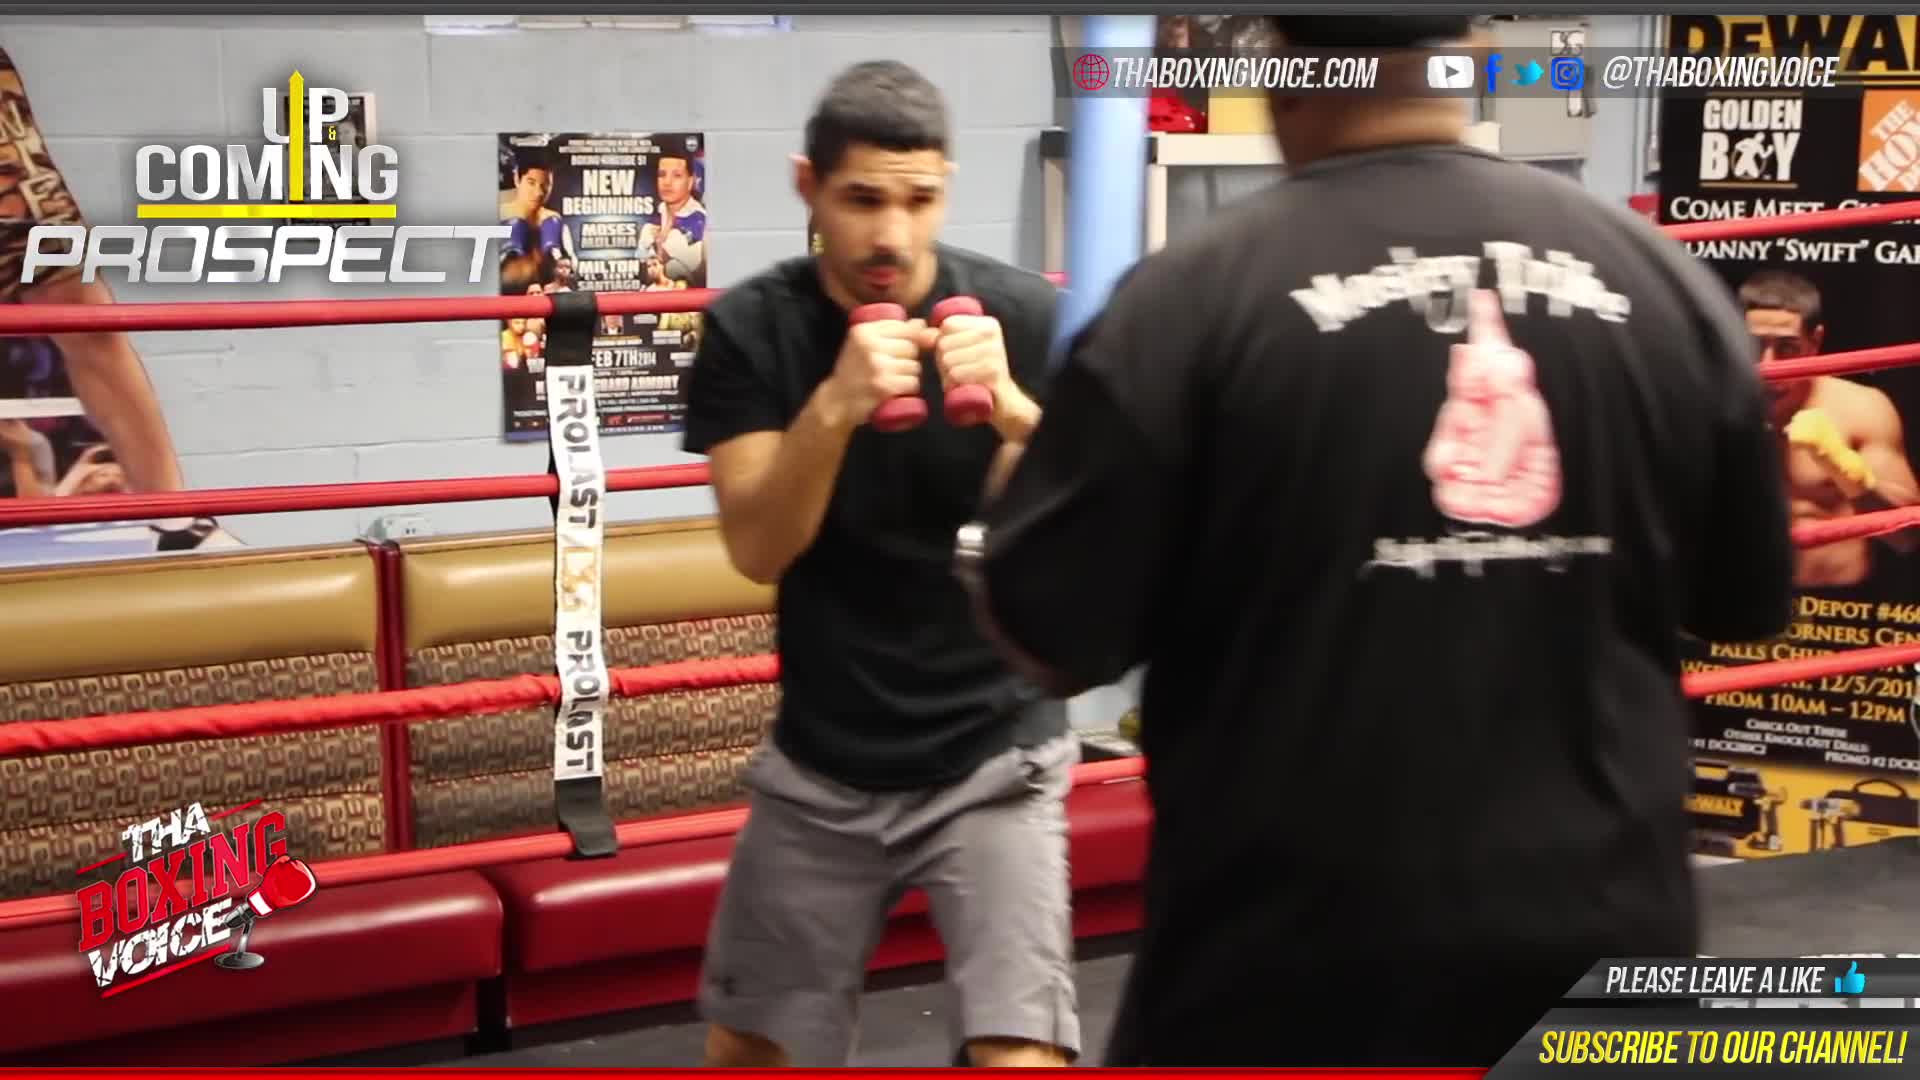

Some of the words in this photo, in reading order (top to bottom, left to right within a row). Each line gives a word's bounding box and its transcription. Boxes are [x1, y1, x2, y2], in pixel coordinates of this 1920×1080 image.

[1703, 99, 1803, 130] GOLDEN
[583, 169, 635, 195] NEW
[562, 197, 654, 215] BEGINNINGS
[1670, 196, 1745, 220] COME
[582, 223, 637, 236] MOSES
[578, 260, 640, 274] MILTON
[613, 349, 638, 367] 7TH
[1801, 596, 1873, 620] DEPOT
[1786, 622, 1870, 644] ORNERS
[1711, 643, 1766, 660] FALLS
[1771, 694, 1827, 715] 10AM
[1850, 700, 1906, 723] 12PM
